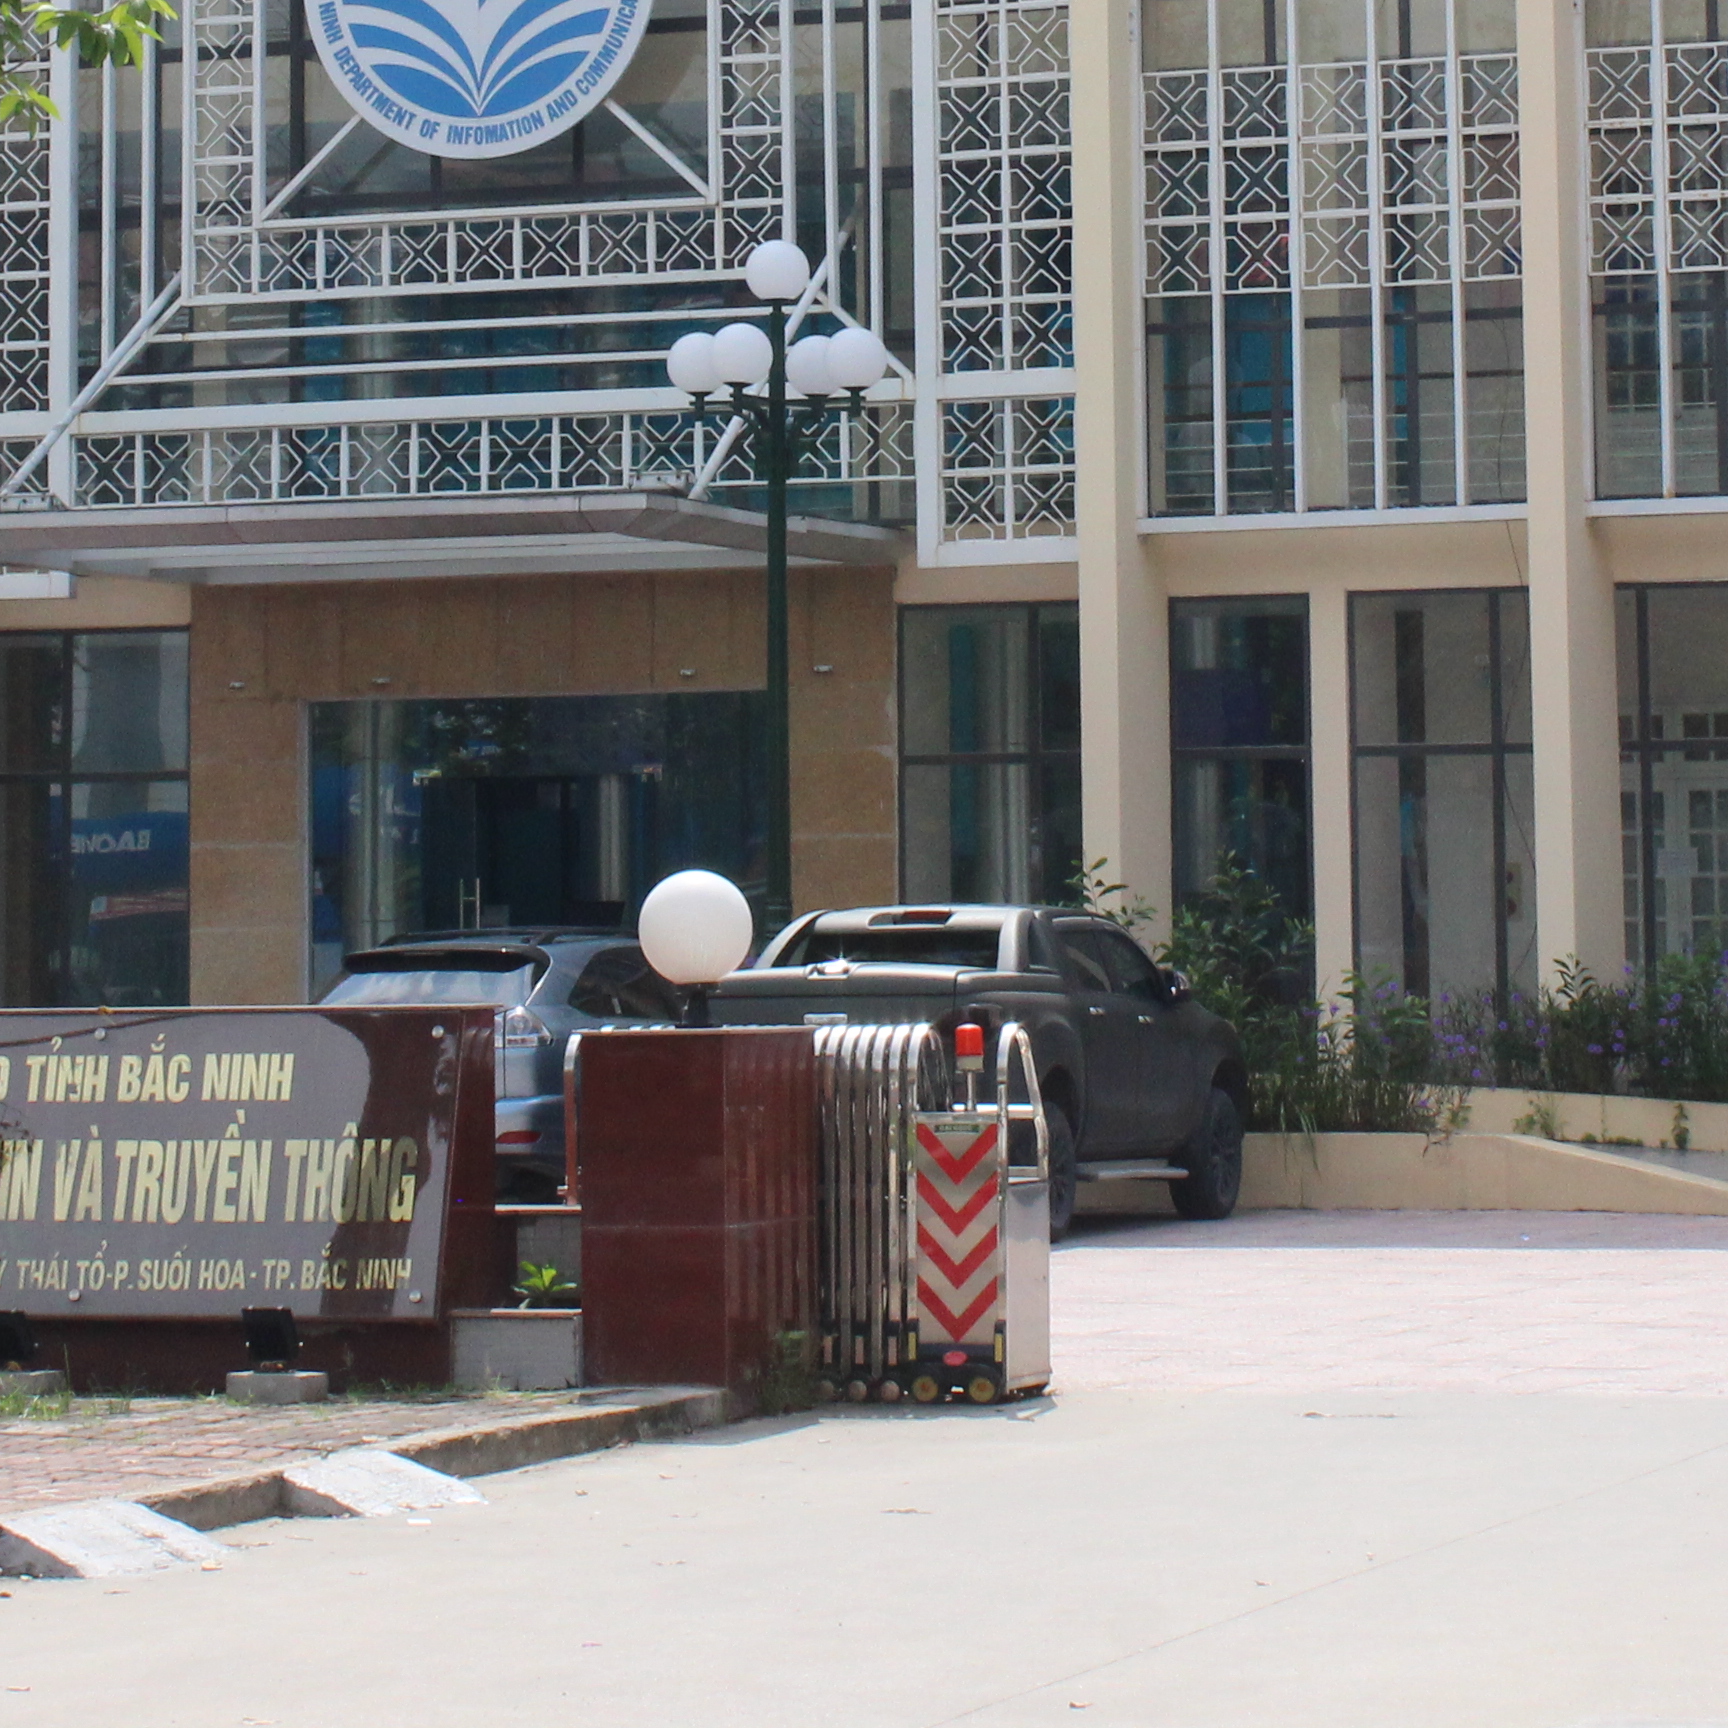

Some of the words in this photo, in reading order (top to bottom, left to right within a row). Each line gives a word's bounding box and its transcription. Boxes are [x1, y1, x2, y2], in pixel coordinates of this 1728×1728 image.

[318, 1, 344, 44] NINH
[333, 46, 417, 130] DEPARTMENT
[419, 118, 441, 140] OF
[446, 110, 545, 145] INFOMATION
[546, 89, 578, 122] AND
[26, 1036, 109, 1103] TỈNH
[117, 1034, 192, 1103] BẮC
[201, 1053, 294, 1101] NINH
[54, 1125, 103, 1221] VÀ
[112, 1109, 273, 1223] TRUYỀN
[284, 1122, 418, 1223] THÔNG
[17, 1252, 69, 1290] THÁI
[198, 1258, 246, 1290] HOA
[355, 1258, 413, 1290] NINH
